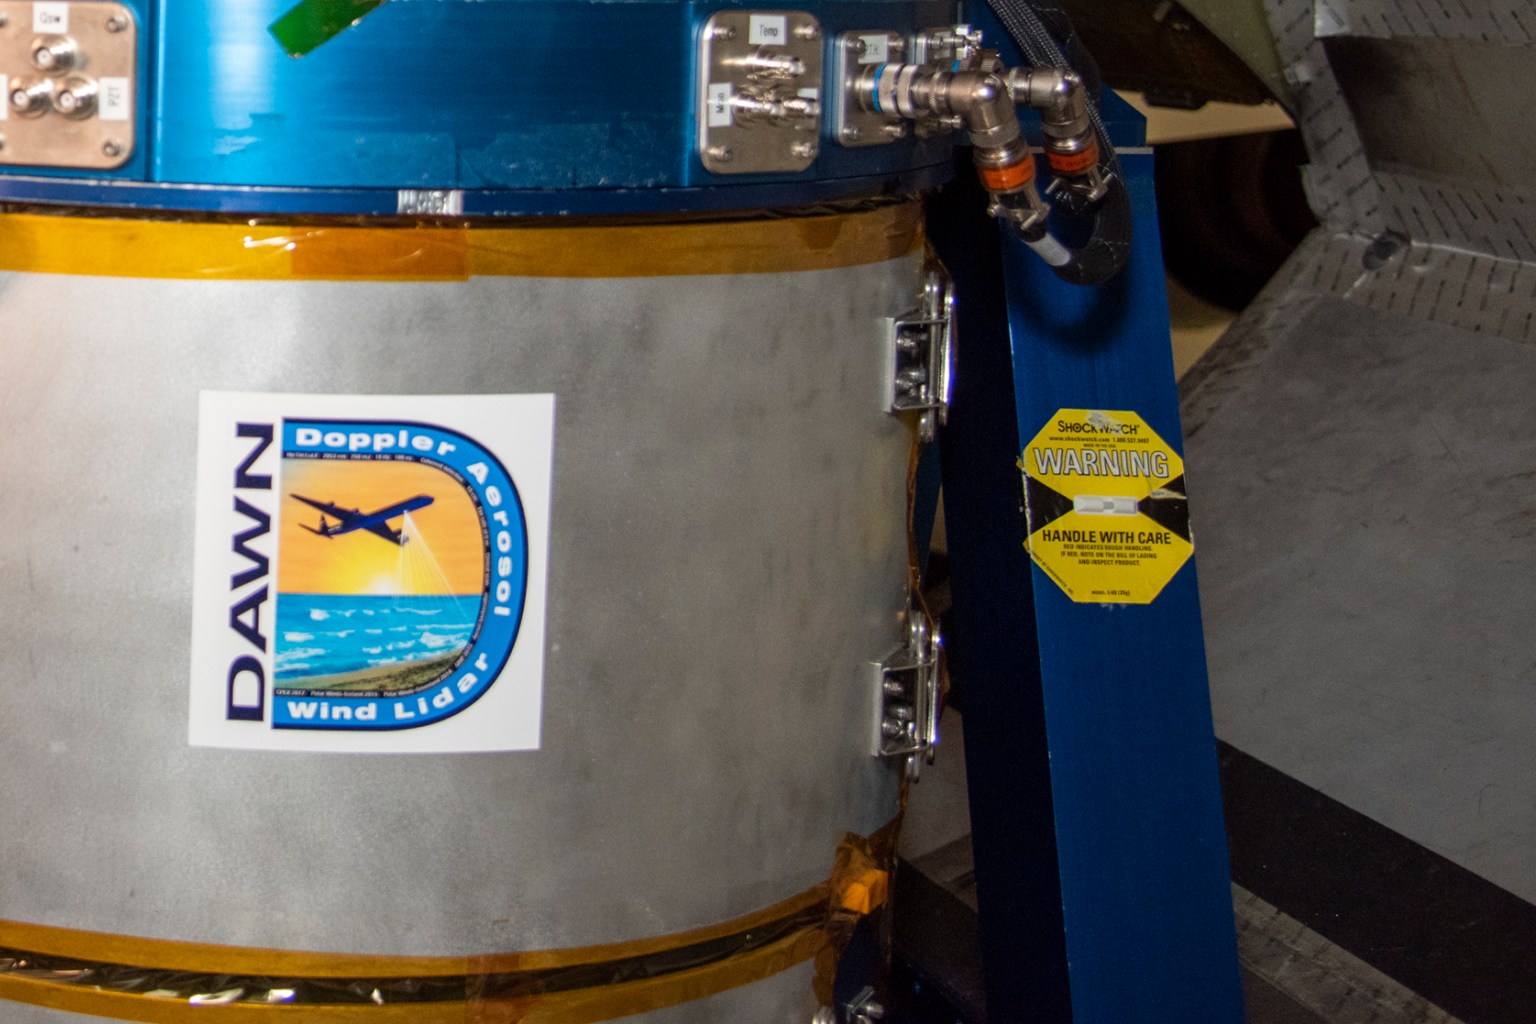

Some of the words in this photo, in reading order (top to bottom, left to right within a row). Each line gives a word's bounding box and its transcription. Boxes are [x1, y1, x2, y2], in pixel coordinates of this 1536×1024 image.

[759, 23, 779, 37] Temp
[107, 86, 121, 108] PZT
[1033, 448, 1169, 478] WARNING
[294, 426, 457, 457] Doppler
[465, 460, 513, 619] Aerosol
[1042, 529, 1097, 543] HANDLE
[1099, 530, 1135, 544] WITH
[1138, 531, 1172, 545] CARE
[225, 421, 275, 722] DAWN
[286, 699, 378, 721] Wind
[394, 651, 490, 720] Lidar
